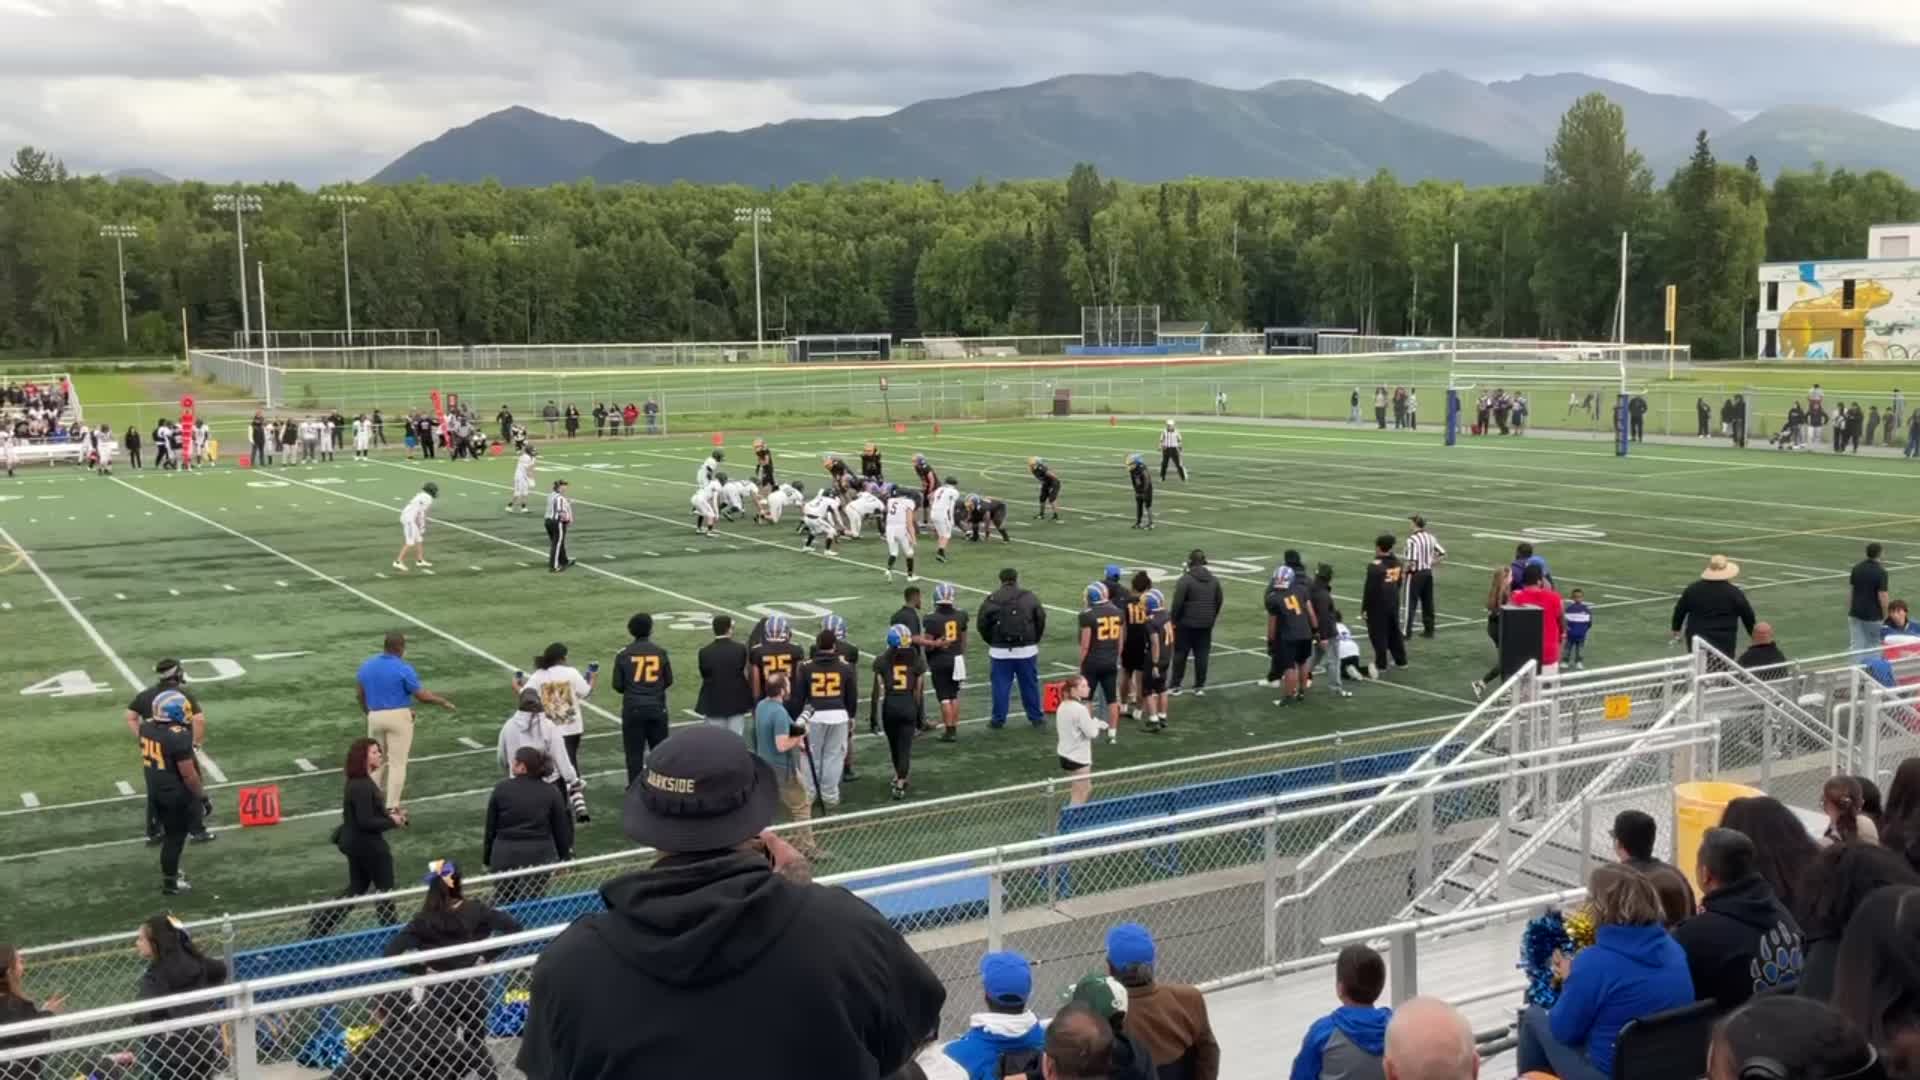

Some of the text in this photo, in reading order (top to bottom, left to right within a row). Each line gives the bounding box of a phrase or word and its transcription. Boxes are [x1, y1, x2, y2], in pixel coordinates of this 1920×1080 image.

[1284, 596, 1301, 616] 4
[944, 620, 958, 642] 8
[1097, 617, 1121, 640] 26
[631, 656, 661, 683] 72
[762, 654, 793, 682] 25
[892, 664, 909, 690] 5
[810, 672, 842, 697] 22
[140, 736, 166, 770] 24
[241, 793, 276, 819] 40
